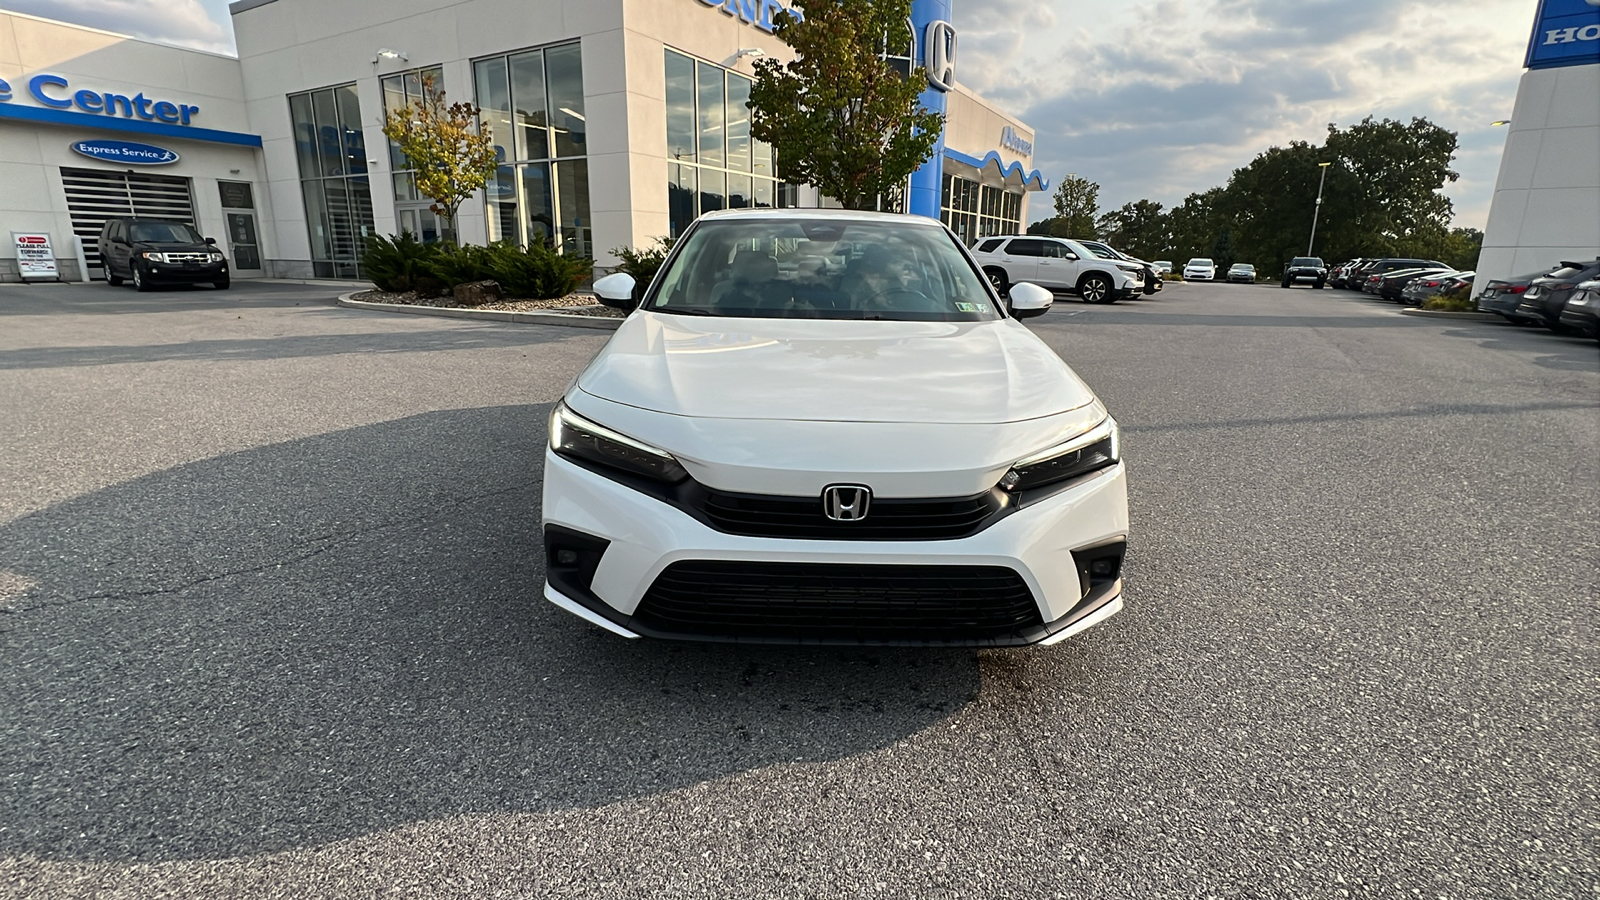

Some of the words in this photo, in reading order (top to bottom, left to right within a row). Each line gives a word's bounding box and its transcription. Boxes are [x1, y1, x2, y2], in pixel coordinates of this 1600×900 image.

[1542, 25, 1600, 45] HO
[29, 74, 199, 125] Center
[80, 144, 120, 154] Express
[122, 148, 159, 158] Service
